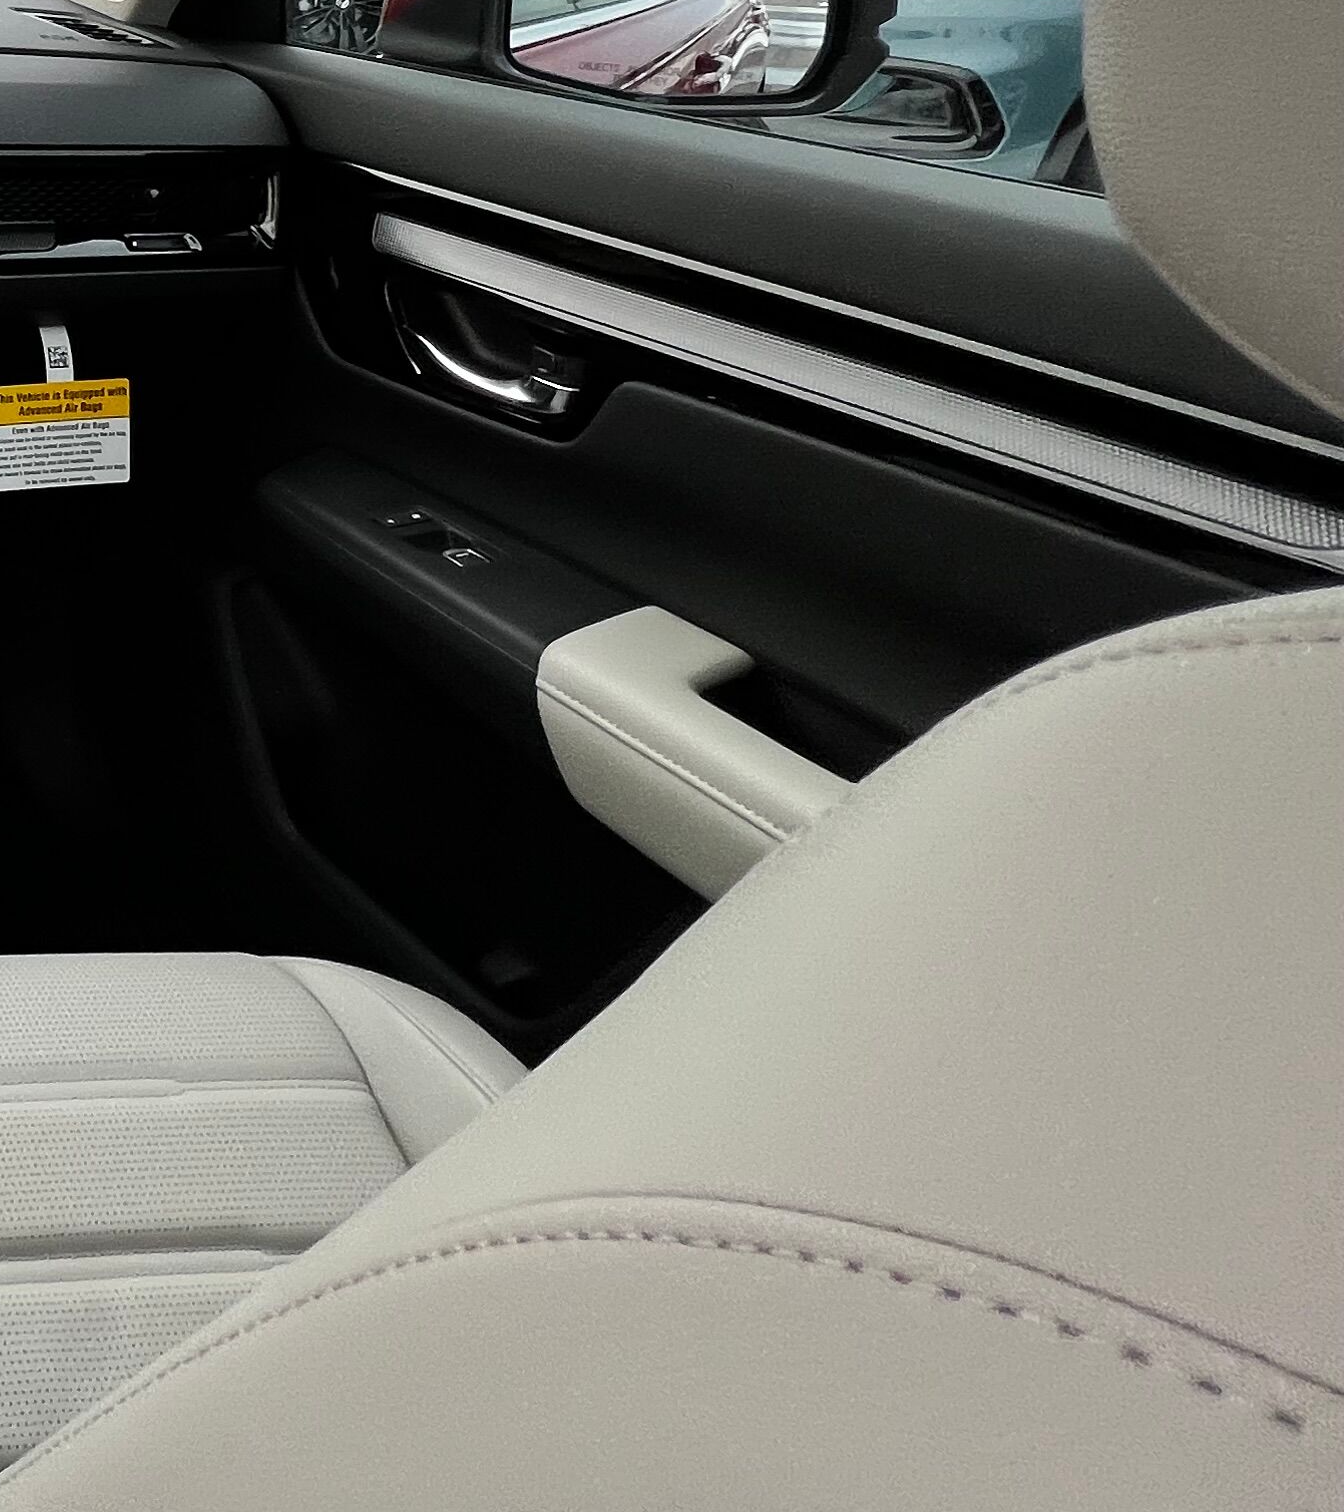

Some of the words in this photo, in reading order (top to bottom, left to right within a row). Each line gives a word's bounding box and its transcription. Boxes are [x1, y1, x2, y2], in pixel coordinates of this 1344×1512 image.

[16, 392, 51, 403] Vehicle
[52, 390, 61, 400] is
[63, 387, 105, 401] Equipped
[107, 386, 127, 396] with
[19, 404, 62, 416] Advanced
[64, 402, 78, 413] Air
[81, 401, 103, 413] Bags
[12, 426, 28, 435] Even
[30, 425, 44, 433] with
[46, 423, 79, 432] Advanced
[81, 422, 91, 430] Air
[92, 421, 110, 430] Bags
